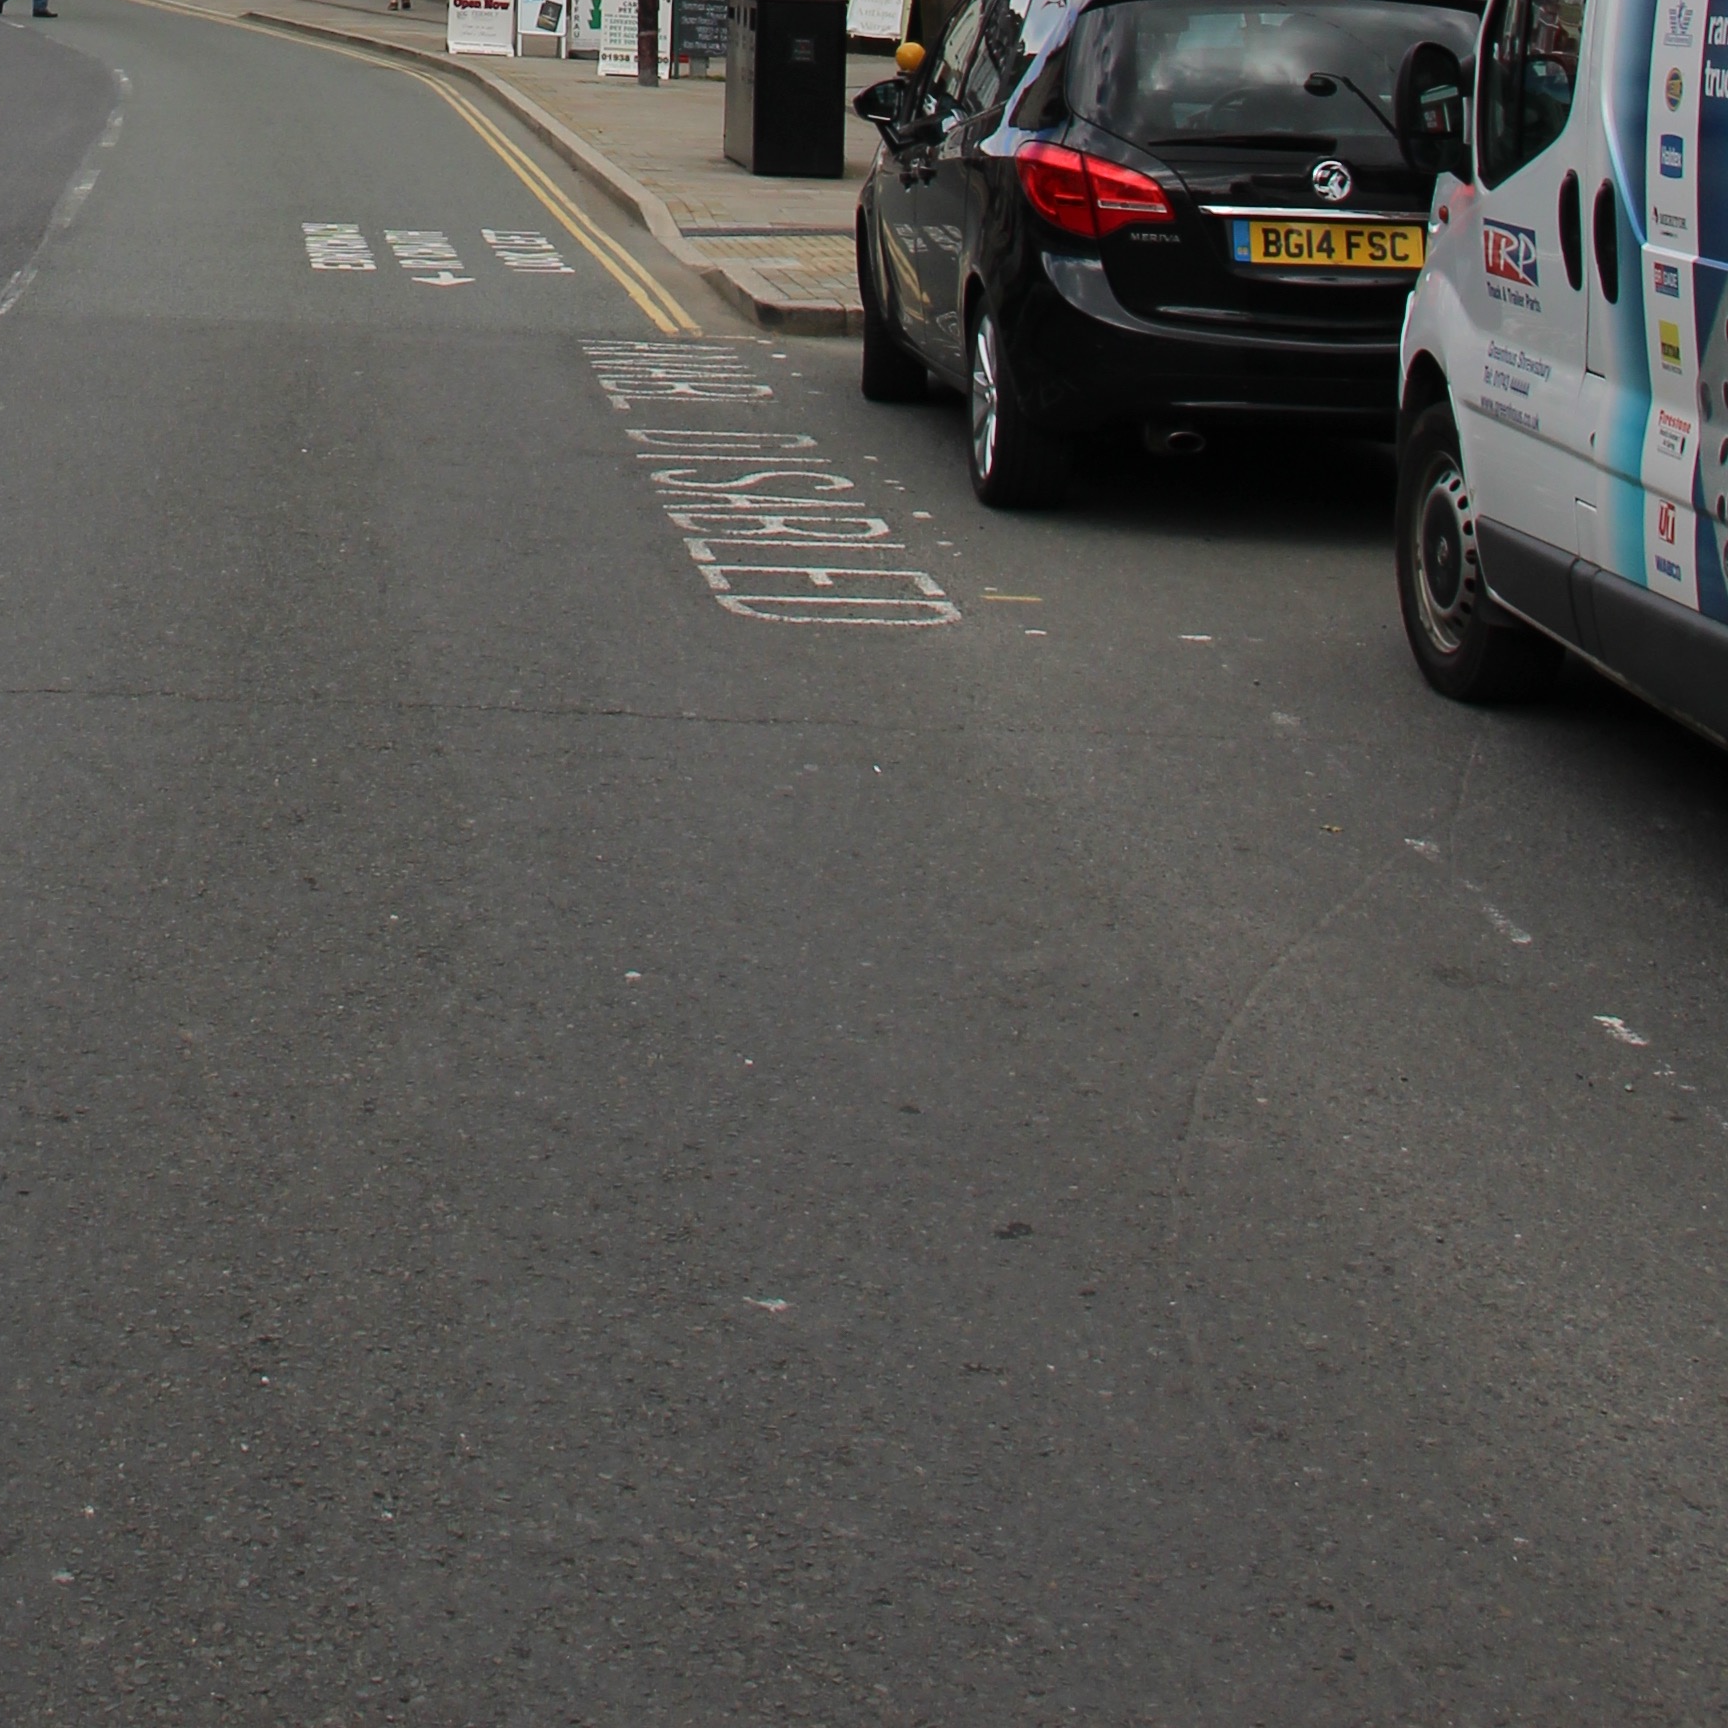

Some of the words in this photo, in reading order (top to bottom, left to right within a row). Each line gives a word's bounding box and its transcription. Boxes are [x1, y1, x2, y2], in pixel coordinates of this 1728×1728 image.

[601, 53, 630, 62] 01938
[1130, 231, 1181, 244] MERIVA
[1262, 227, 1336, 259] BG14
[1345, 230, 1410, 262] FSC
[1483, 223, 1539, 288] TRP
[1486, 281, 1502, 301] Truck
[1507, 287, 1525, 307] Trailer
[1525, 292, 1542, 313] Parts
[1659, 409, 1692, 435] Firestone
[624, 428, 964, 627] DISABLED
